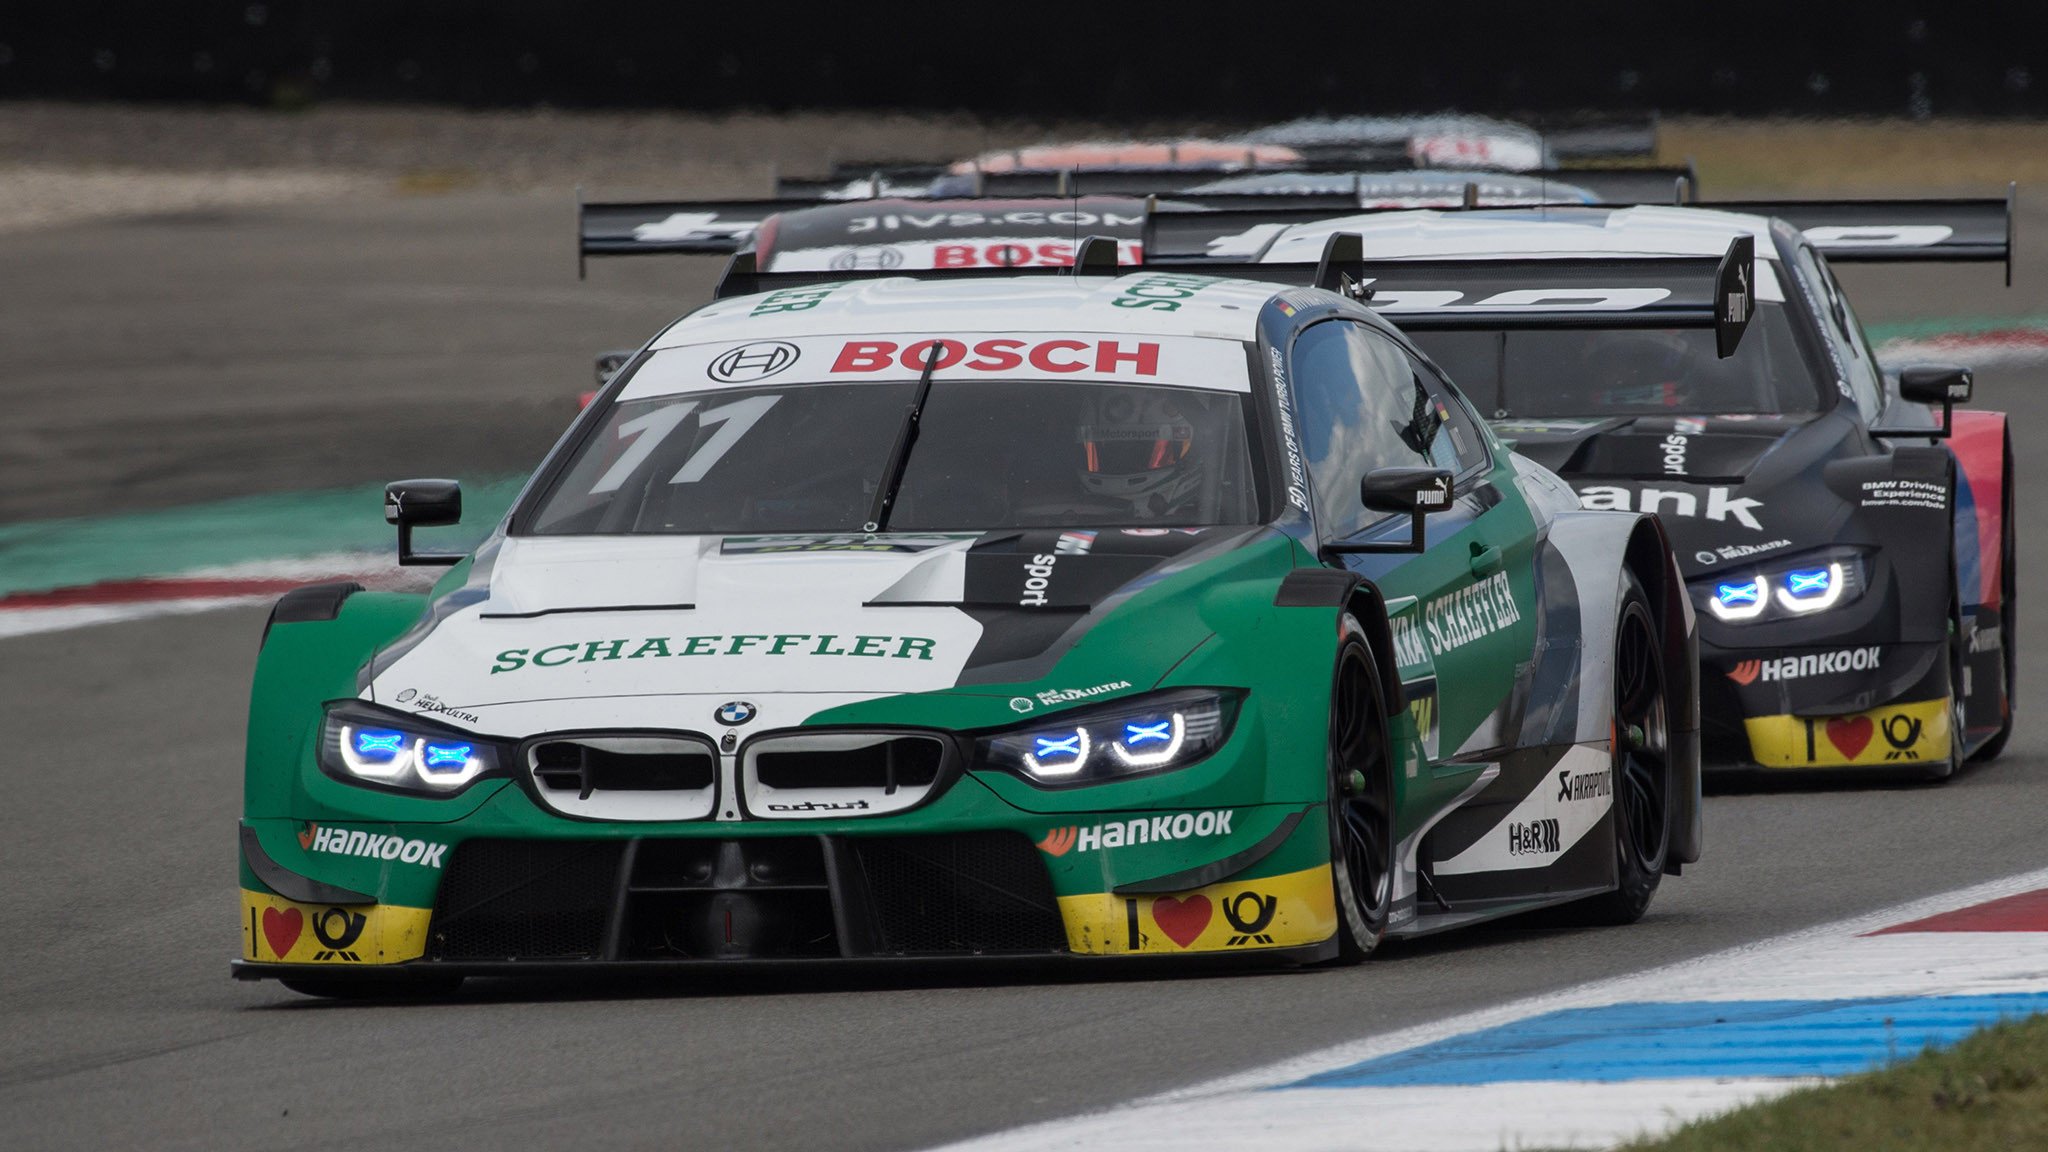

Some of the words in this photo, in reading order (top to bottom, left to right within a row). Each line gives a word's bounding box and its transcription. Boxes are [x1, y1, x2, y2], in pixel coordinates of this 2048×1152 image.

[933, 244, 1142, 269] BOS
[830, 339, 1160, 376] BOSCH
[1270, 346, 1286, 380] POWER
[1275, 377, 1291, 411] TURBO
[1280, 409, 1296, 438] BMW
[588, 395, 784, 495] 11
[1285, 435, 1299, 453] OF
[1288, 452, 1305, 489] YEARS
[1288, 485, 1309, 513] 50
[1416, 490, 1444, 505] PUMA
[1862, 481, 1897, 490] BMW
[1899, 480, 1946, 493] Driving
[1873, 489, 1946, 502] Experience
[1580, 485, 1765, 531] ank
[1020, 554, 1056, 607] sport
[1425, 570, 1521, 656] SCHAEFFLER
[490, 634, 937, 675] SCHAEFFLER
[1085, 680, 1132, 696] ULTRA
[446, 707, 479, 724] ULTRA
